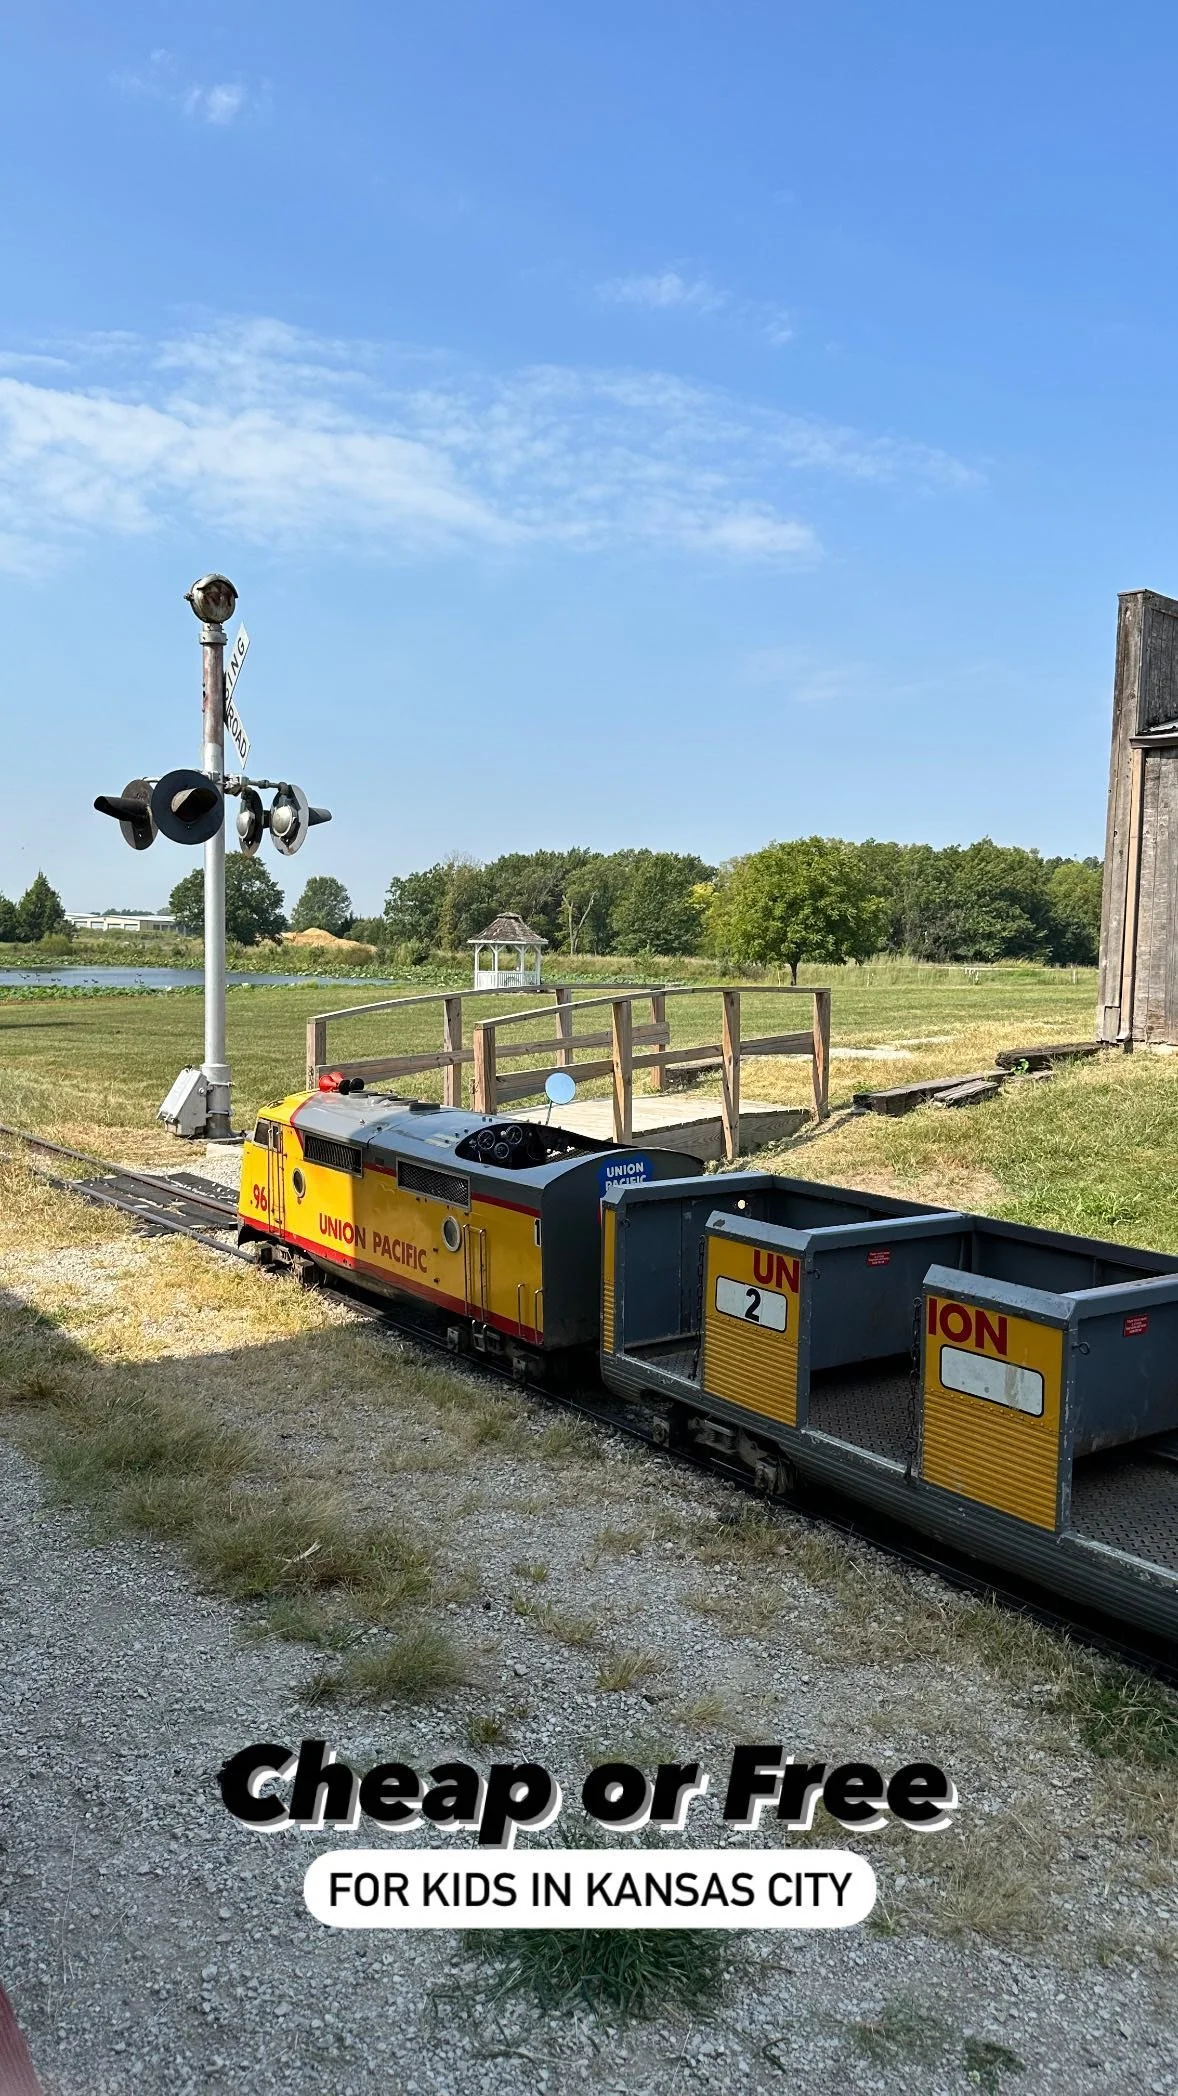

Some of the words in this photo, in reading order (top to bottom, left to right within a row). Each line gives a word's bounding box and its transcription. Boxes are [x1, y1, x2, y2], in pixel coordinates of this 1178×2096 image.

[606, 1161, 645, 1178] UNION
[252, 1183, 268, 1212] 96
[318, 1212, 367, 1250] UNION
[371, 1230, 429, 1274] PACIFIC
[753, 1248, 800, 1294] UN
[744, 1287, 762, 1323] 2
[927, 1297, 1008, 1357] ION
